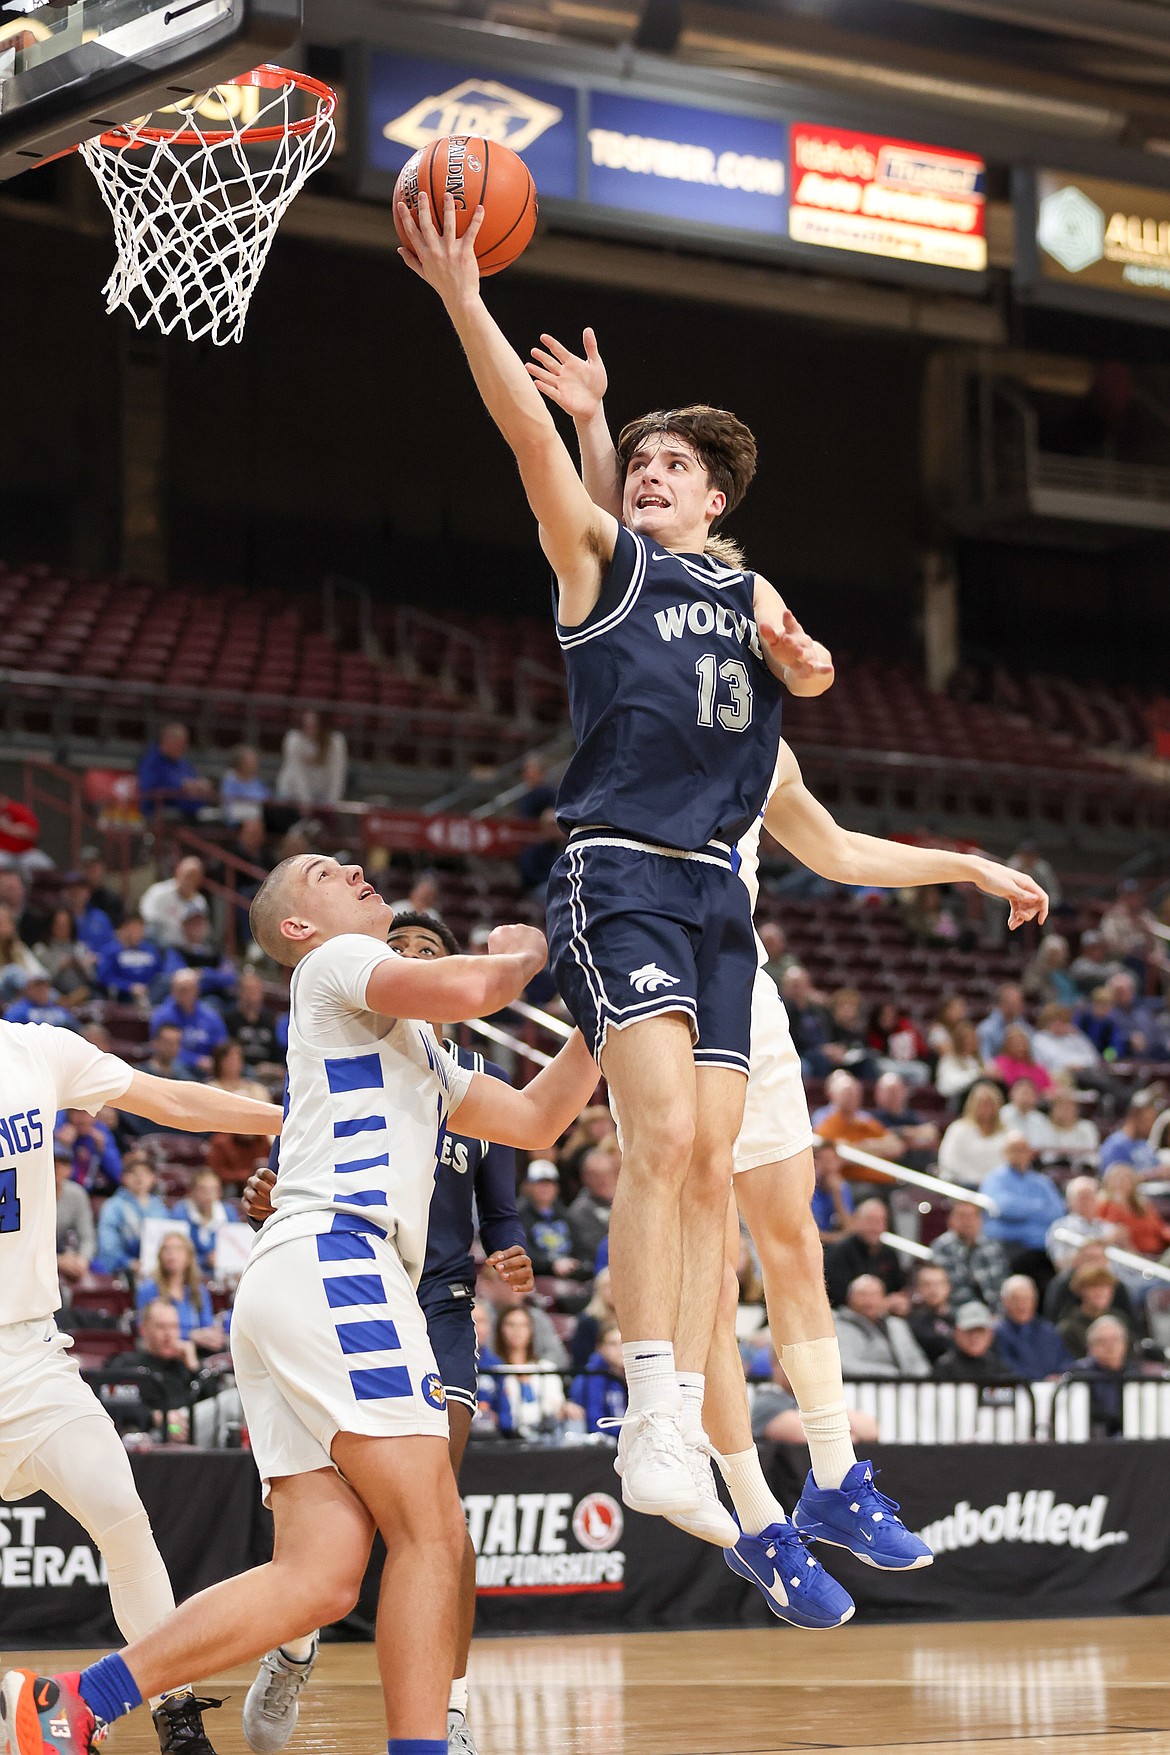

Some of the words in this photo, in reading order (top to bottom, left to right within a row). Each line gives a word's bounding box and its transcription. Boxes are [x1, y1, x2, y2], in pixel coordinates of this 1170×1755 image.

[445, 134, 468, 212] PALDING
[695, 653, 753, 732] 13
[461, 1493, 573, 1555] TATE
[0, 1545, 108, 1587] ERA
